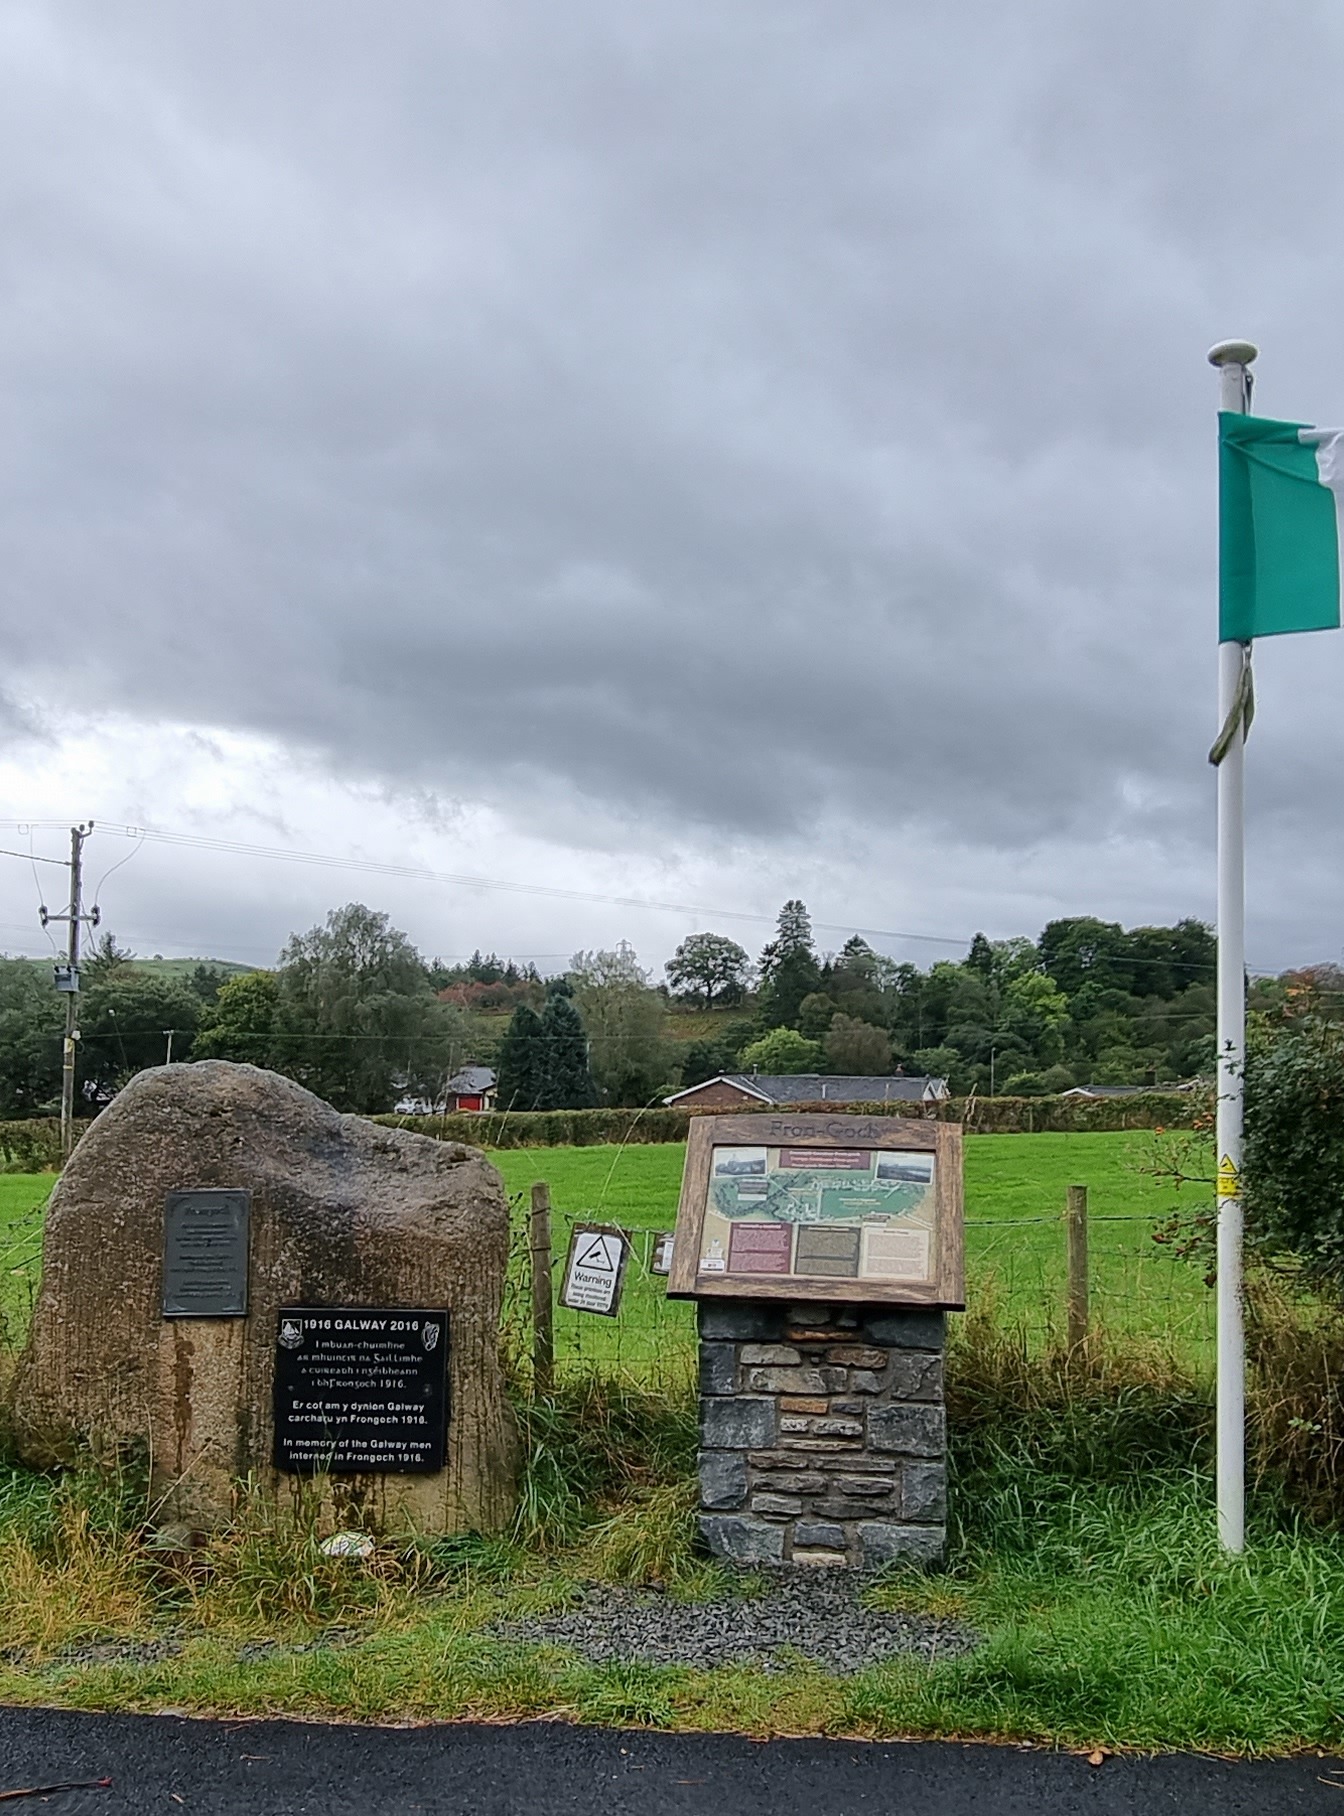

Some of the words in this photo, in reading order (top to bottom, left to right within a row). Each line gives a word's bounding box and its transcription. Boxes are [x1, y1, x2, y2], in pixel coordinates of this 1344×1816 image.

[769, 1120, 881, 1139] Fron-Goch
[574, 1271, 612, 1289] Warning
[304, 1319, 331, 1330] 1916
[334, 1319, 387, 1330] GALWAY
[390, 1320, 419, 1331] 2016
[292, 1400, 304, 1410] Er
[306, 1401, 323, 1409] cof
[325, 1402, 340, 1410] am
[342, 1403, 349, 1412] y
[350, 1401, 385, 1412] dynion
[387, 1402, 424, 1413] Galway
[335, 1416, 348, 1424] yn
[350, 1414, 398, 1425] Frongoch
[283, 1438, 293, 1446] In
[295, 1440, 337, 1449] memory
[338, 1439, 349, 1448] of
[351, 1439, 368, 1448] the
[370, 1440, 407, 1450] Galway
[289, 1451, 333, 1460] interned
[334, 1452, 344, 1461] in
[346, 1452, 395, 1463] Frongoch
